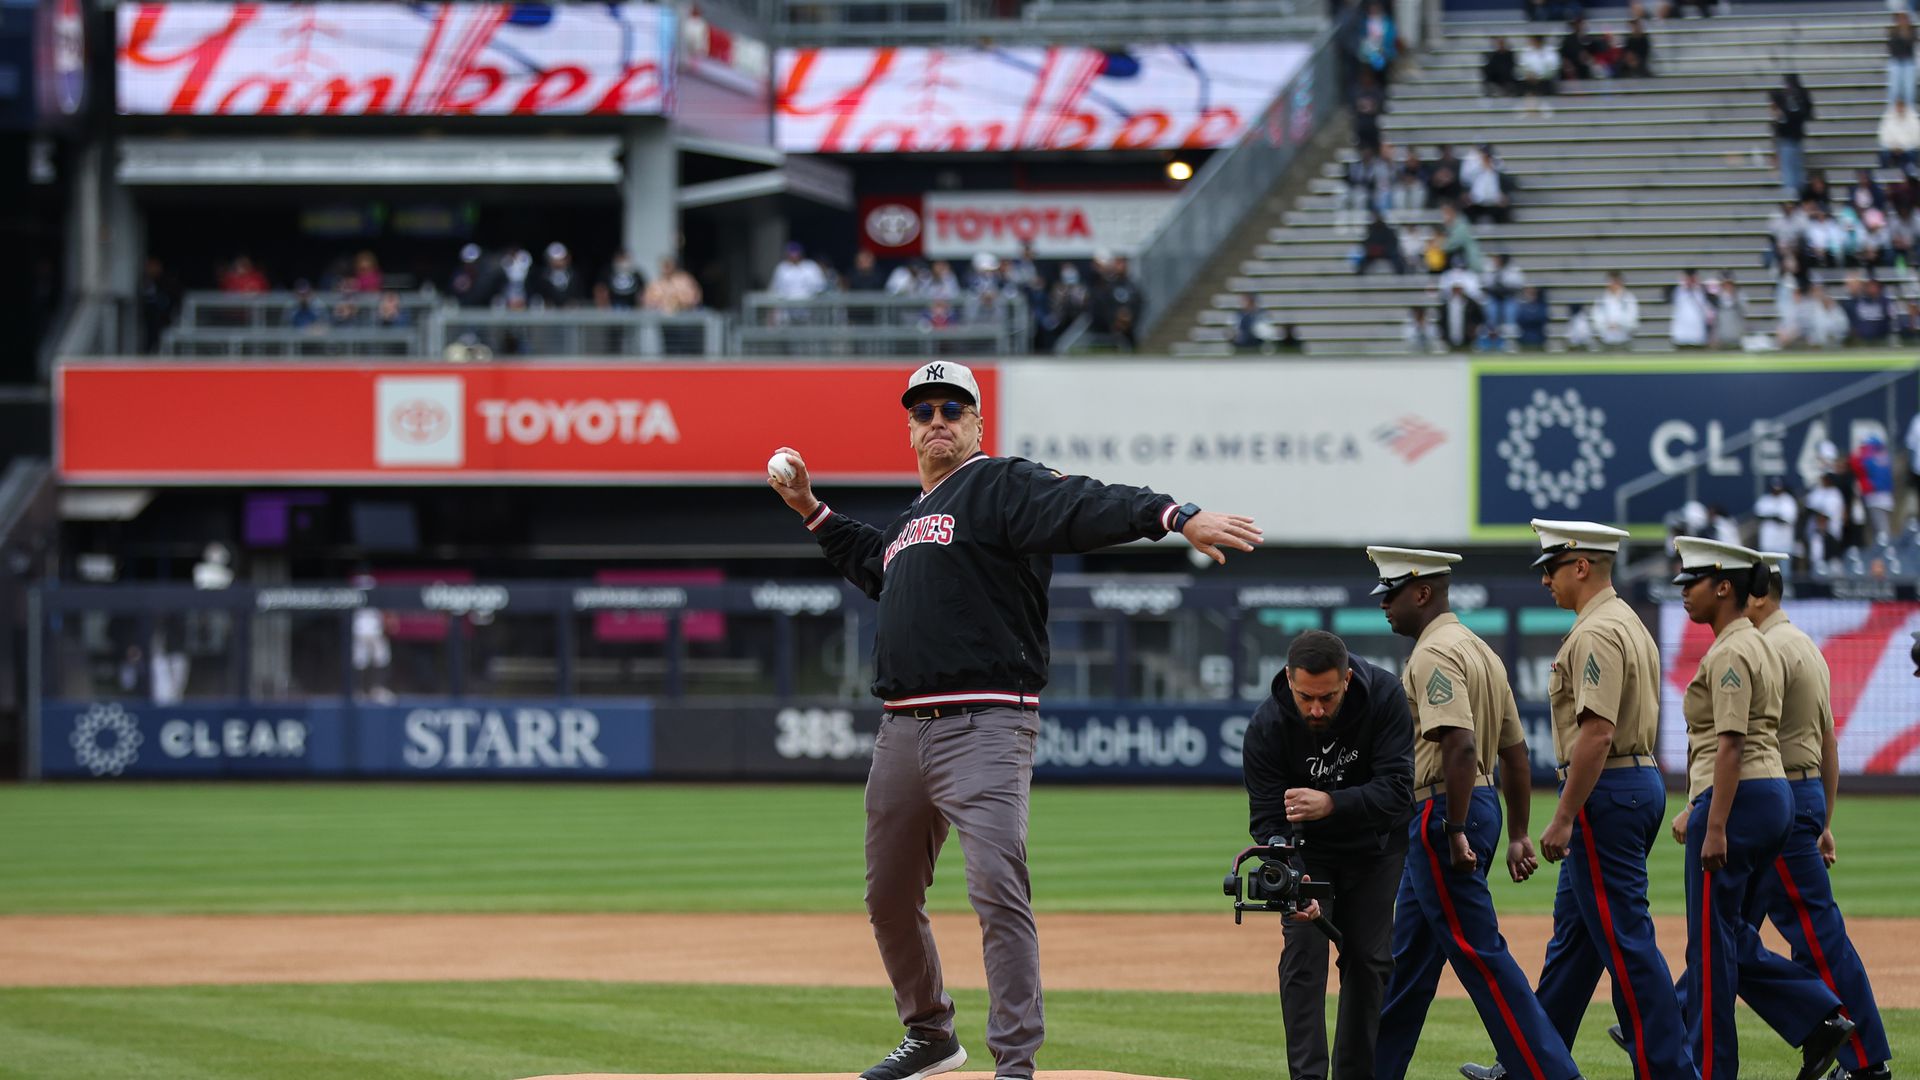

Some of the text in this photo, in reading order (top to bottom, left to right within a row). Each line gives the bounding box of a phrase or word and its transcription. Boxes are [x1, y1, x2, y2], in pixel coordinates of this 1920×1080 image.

[932, 207, 1091, 242] TOYOTA
[926, 364, 945, 381] NY
[476, 397, 681, 445] TOYOTA
[1018, 432, 1362, 465] BANK OF AMERICA
[159, 719, 306, 758] CLEAR
[404, 709, 607, 769] STARR
